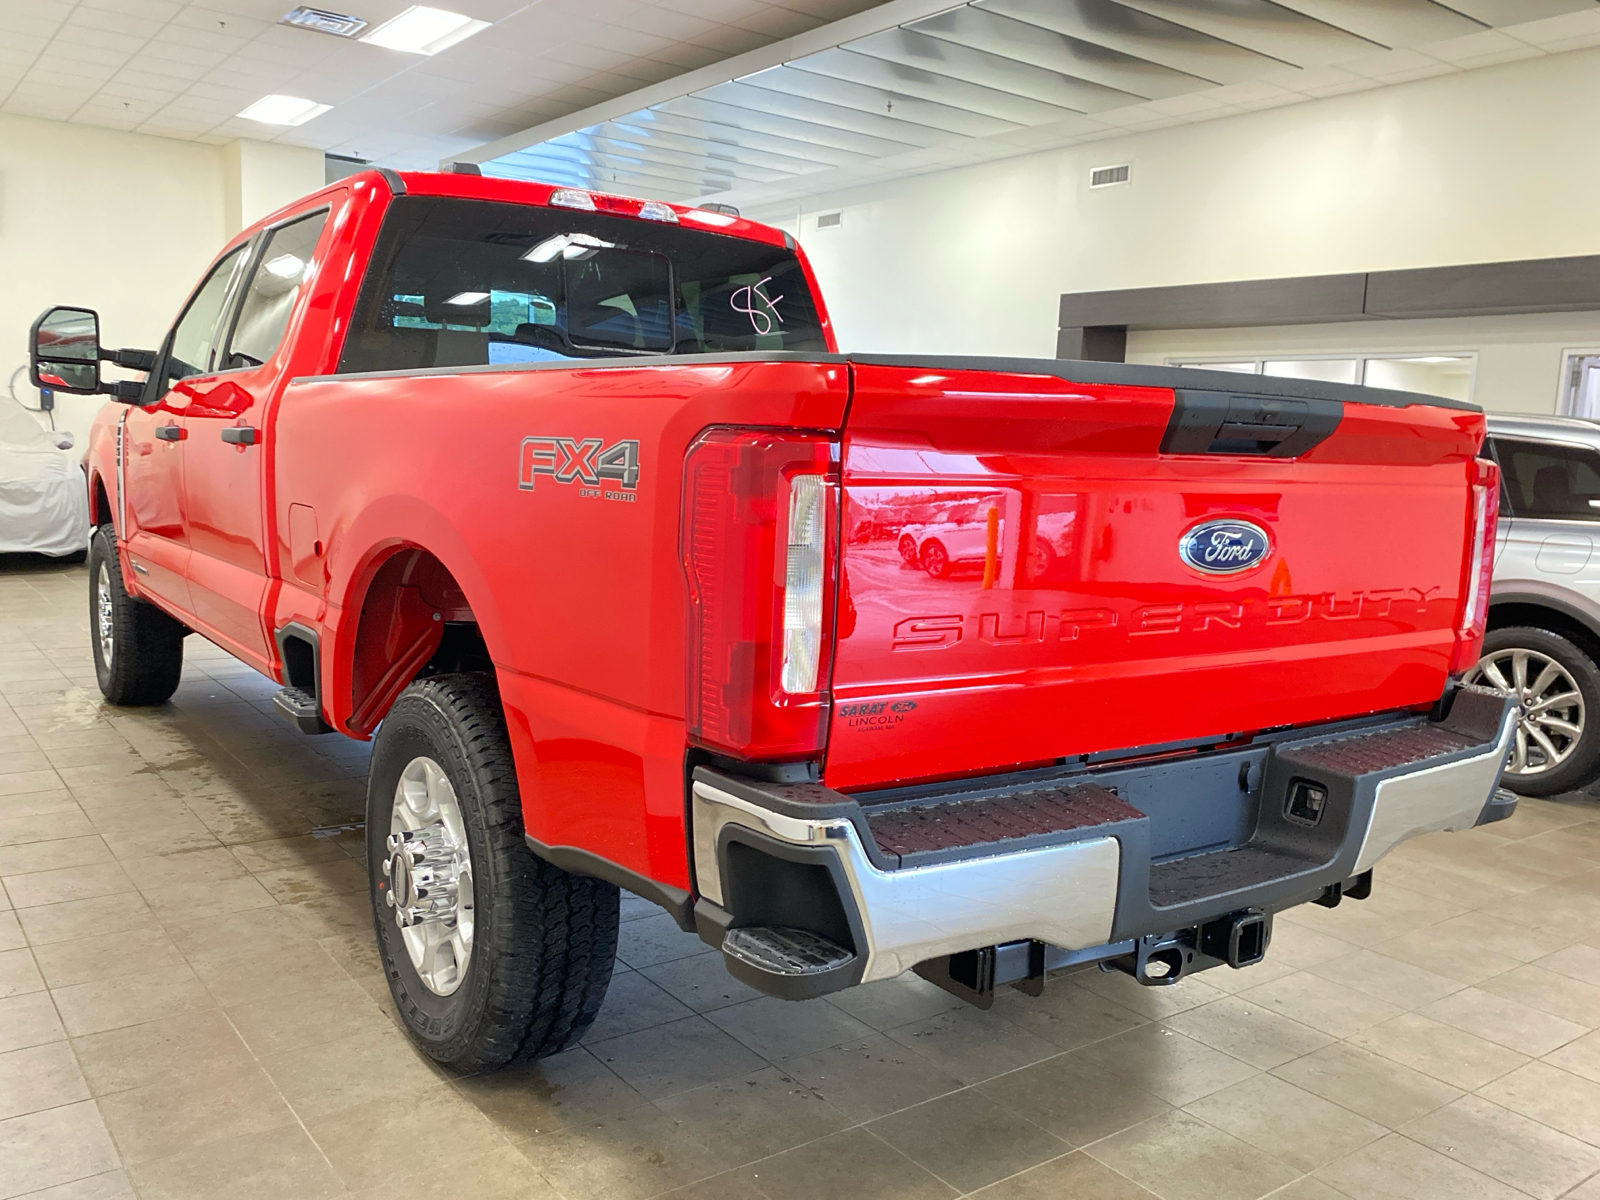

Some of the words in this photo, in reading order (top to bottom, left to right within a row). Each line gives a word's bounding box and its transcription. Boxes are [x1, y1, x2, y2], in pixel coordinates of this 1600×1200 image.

[518, 435, 640, 492] FX4
[579, 488, 601, 498] OFF
[604, 491, 636, 502] ROAD
[1204, 530, 1254, 562] Ford
[892, 601, 1243, 652] SUPER
[1266, 585, 1441, 626] DUTY
[838, 702, 888, 717] SARAT
[848, 714, 904, 727] LINCOLN
